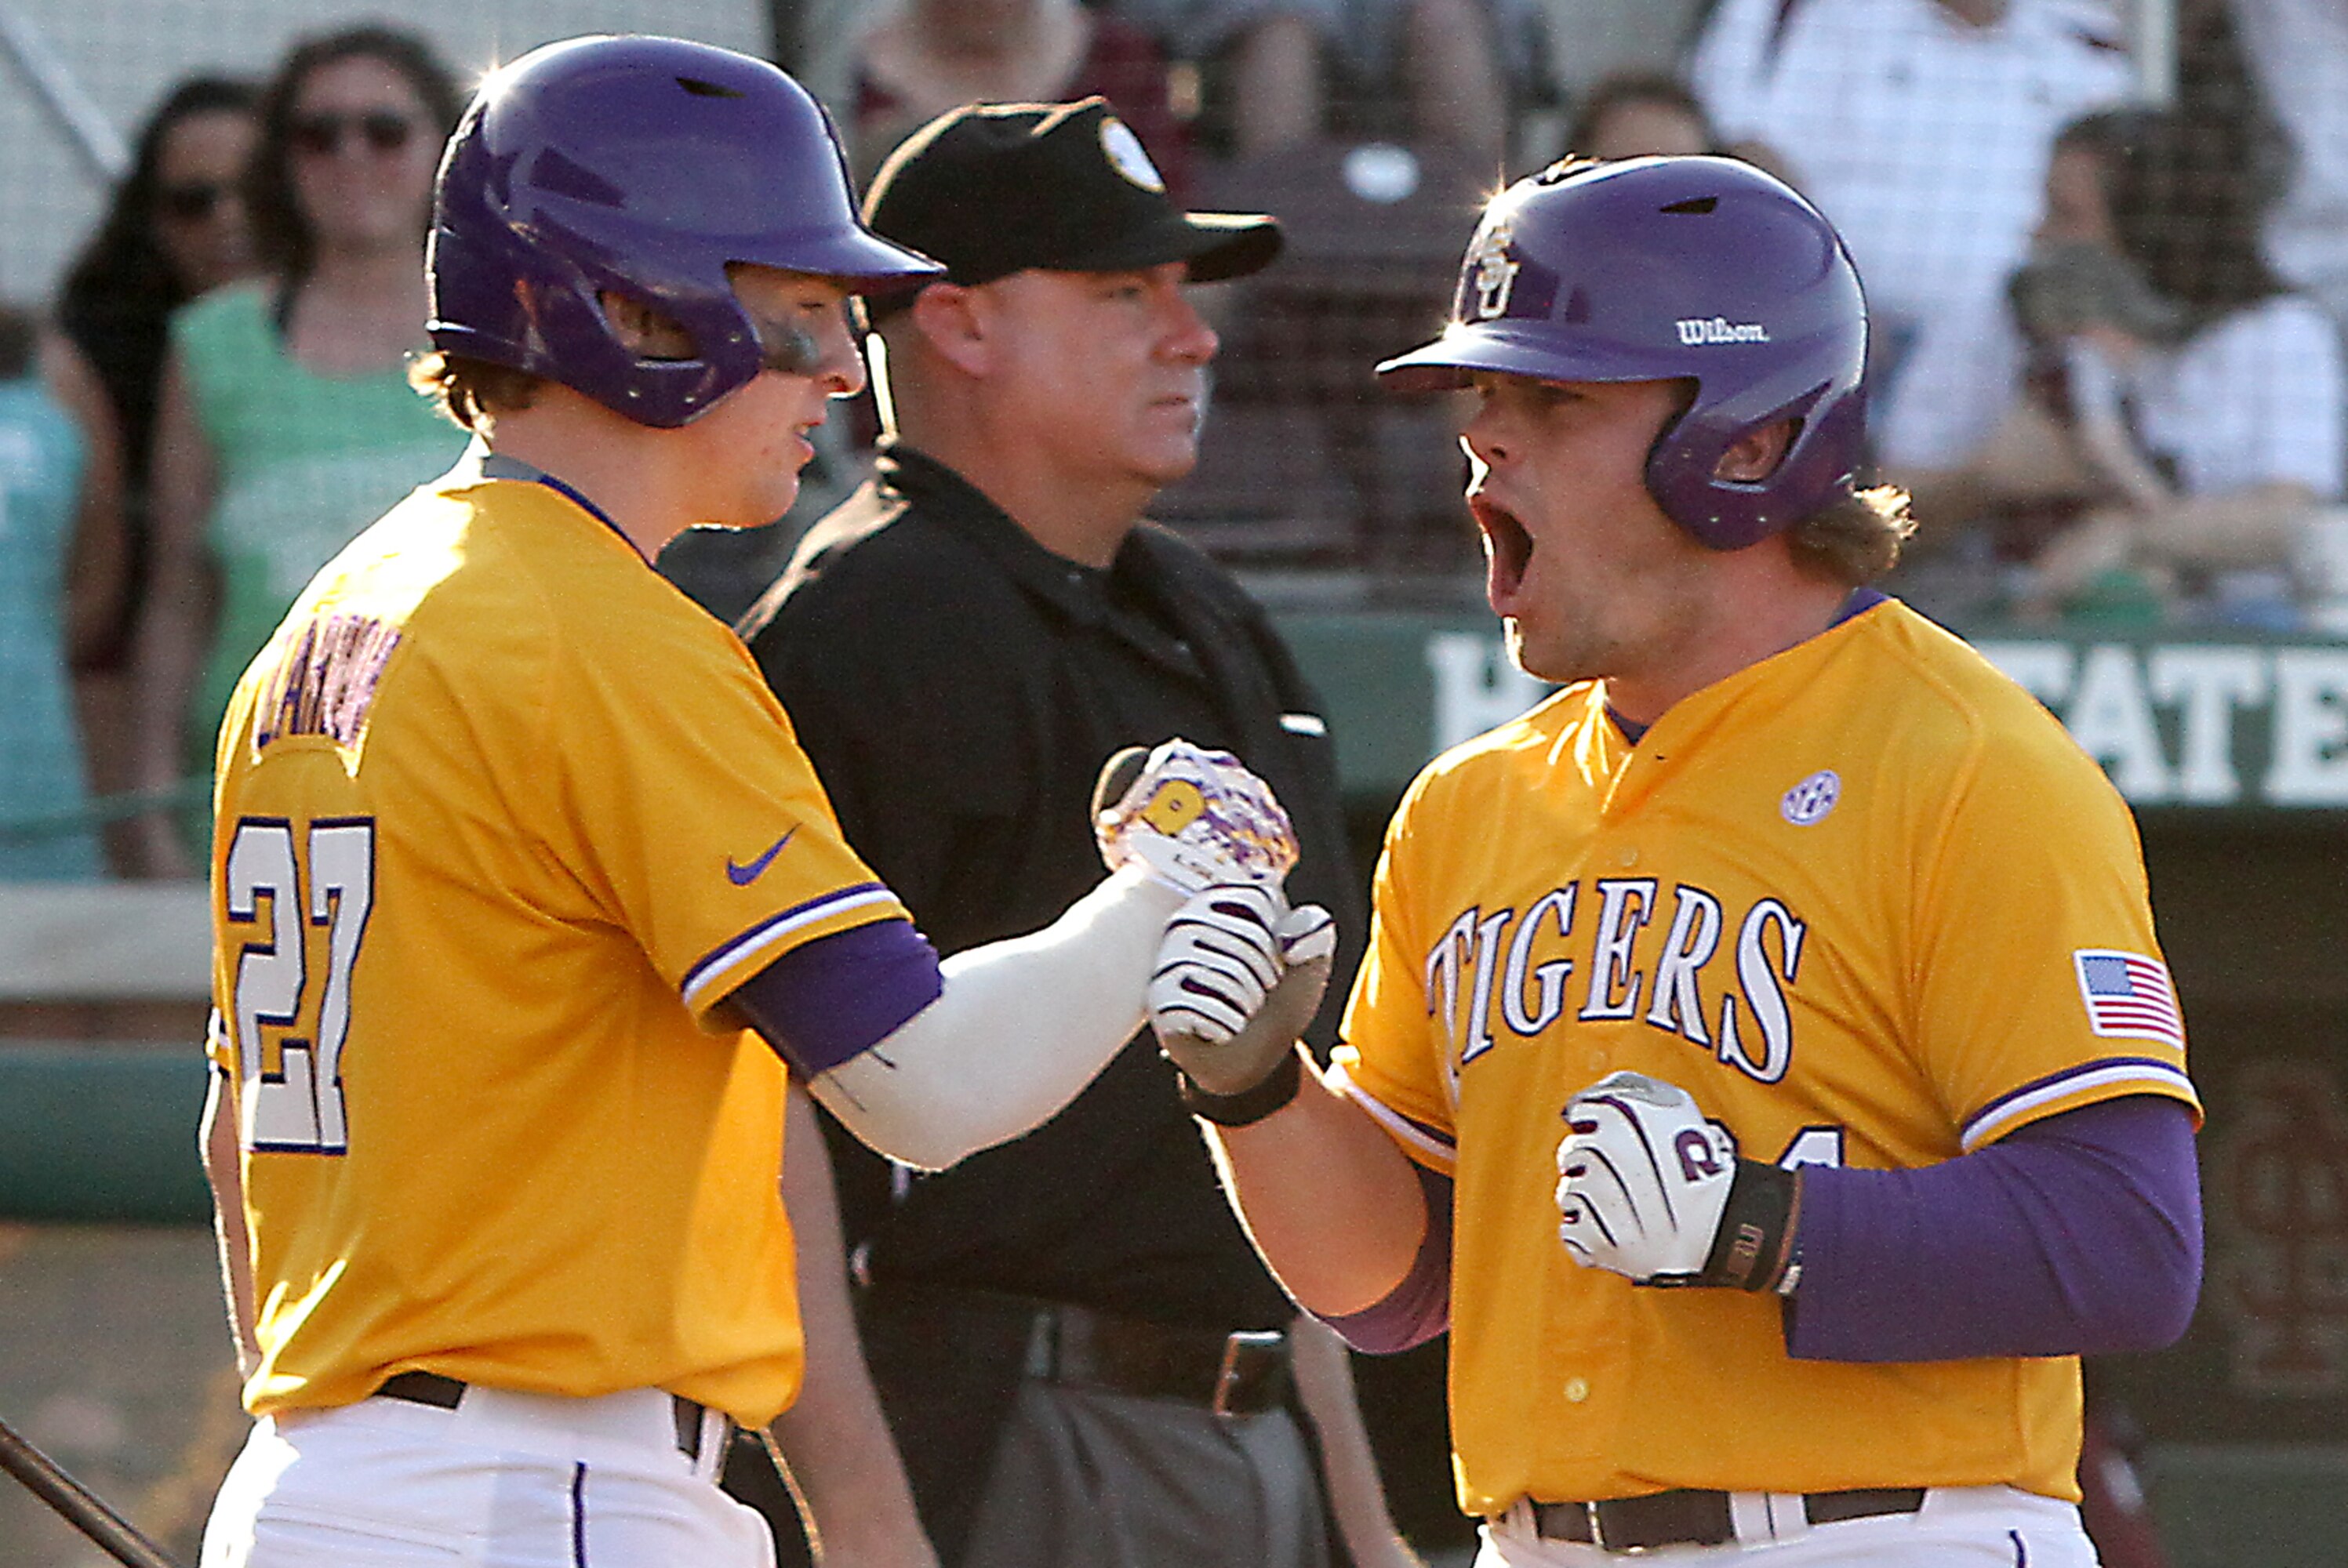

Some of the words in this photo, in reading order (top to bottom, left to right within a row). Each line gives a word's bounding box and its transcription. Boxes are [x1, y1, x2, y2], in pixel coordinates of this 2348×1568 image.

[1675, 317, 1769, 344] Wilson
[227, 816, 375, 1156] 27
[1425, 877, 1806, 1107] TIGERS
